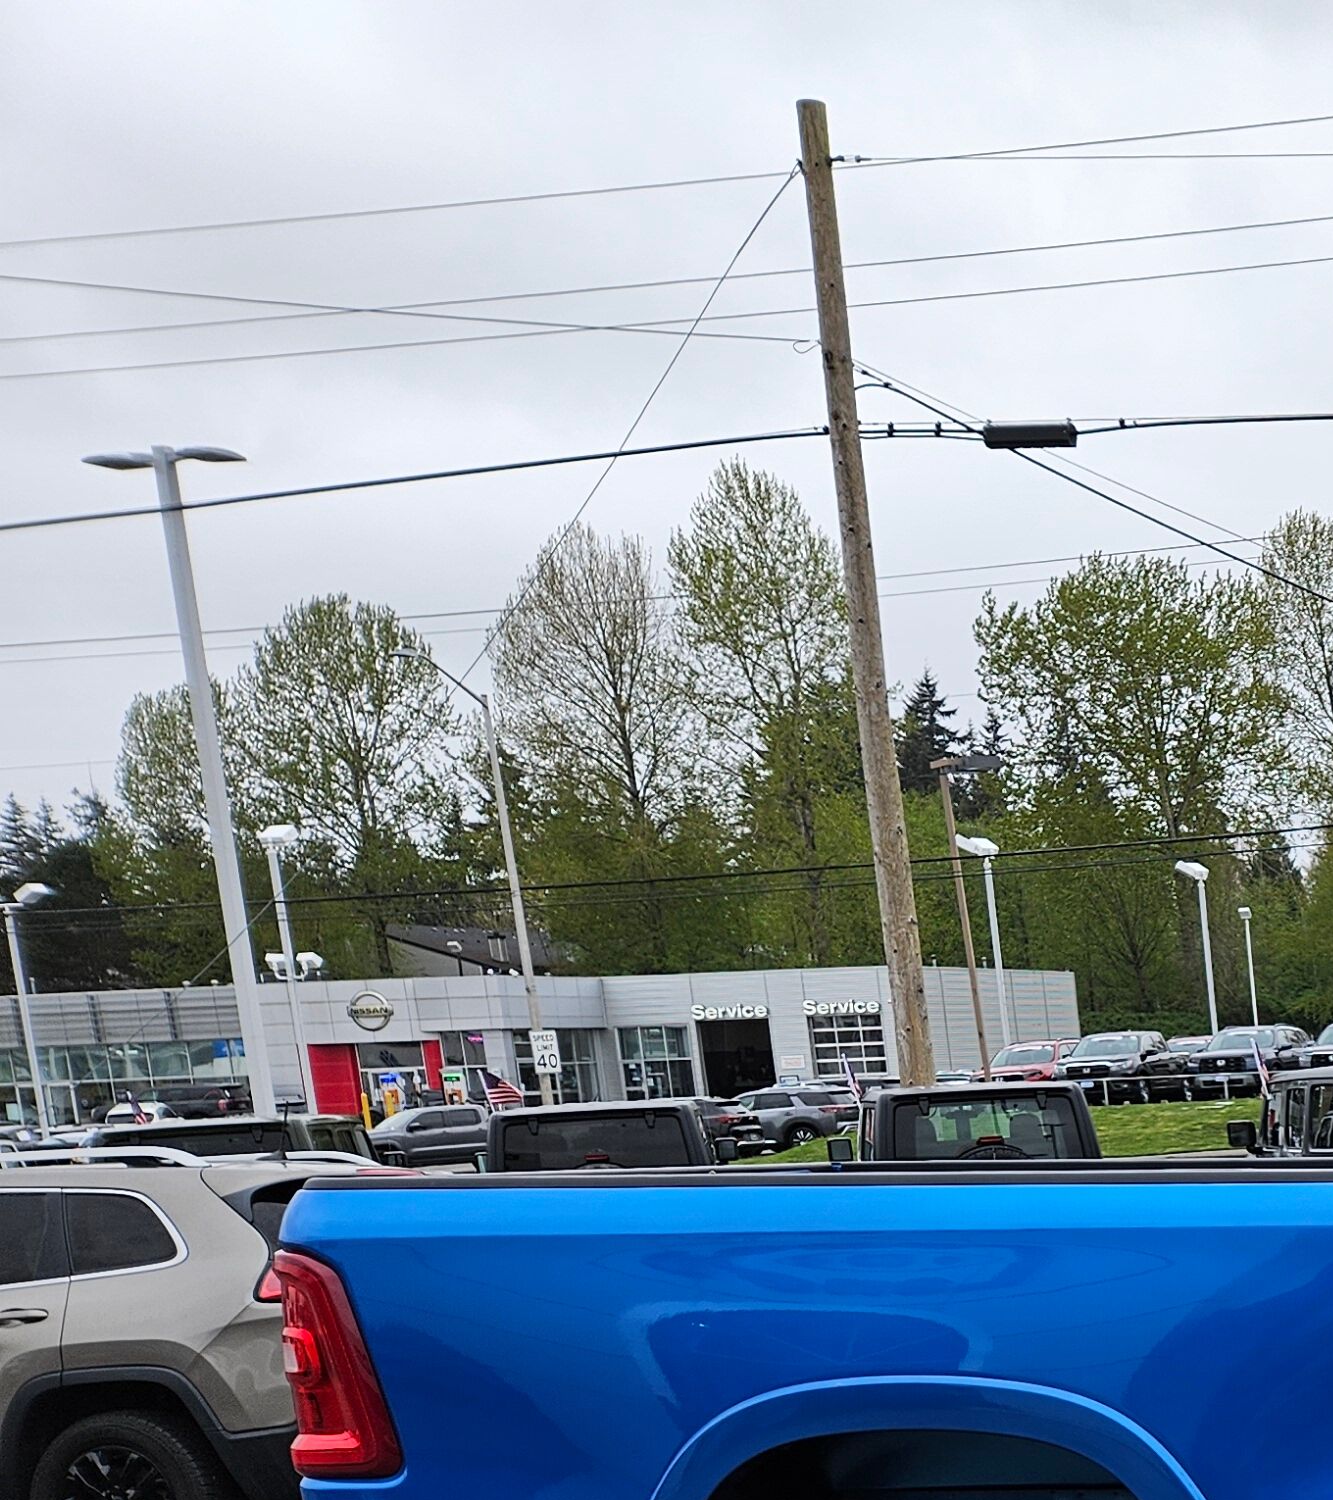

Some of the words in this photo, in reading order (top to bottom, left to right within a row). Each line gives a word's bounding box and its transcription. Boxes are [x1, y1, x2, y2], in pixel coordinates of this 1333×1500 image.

[350, 1006, 388, 1015] NISSAN
[690, 1004, 767, 1019] Service
[802, 999, 879, 1015] Service
[532, 1033, 554, 1042] SPEED
[536, 1043, 553, 1052] LIMIT
[537, 1052, 558, 1069] 40
